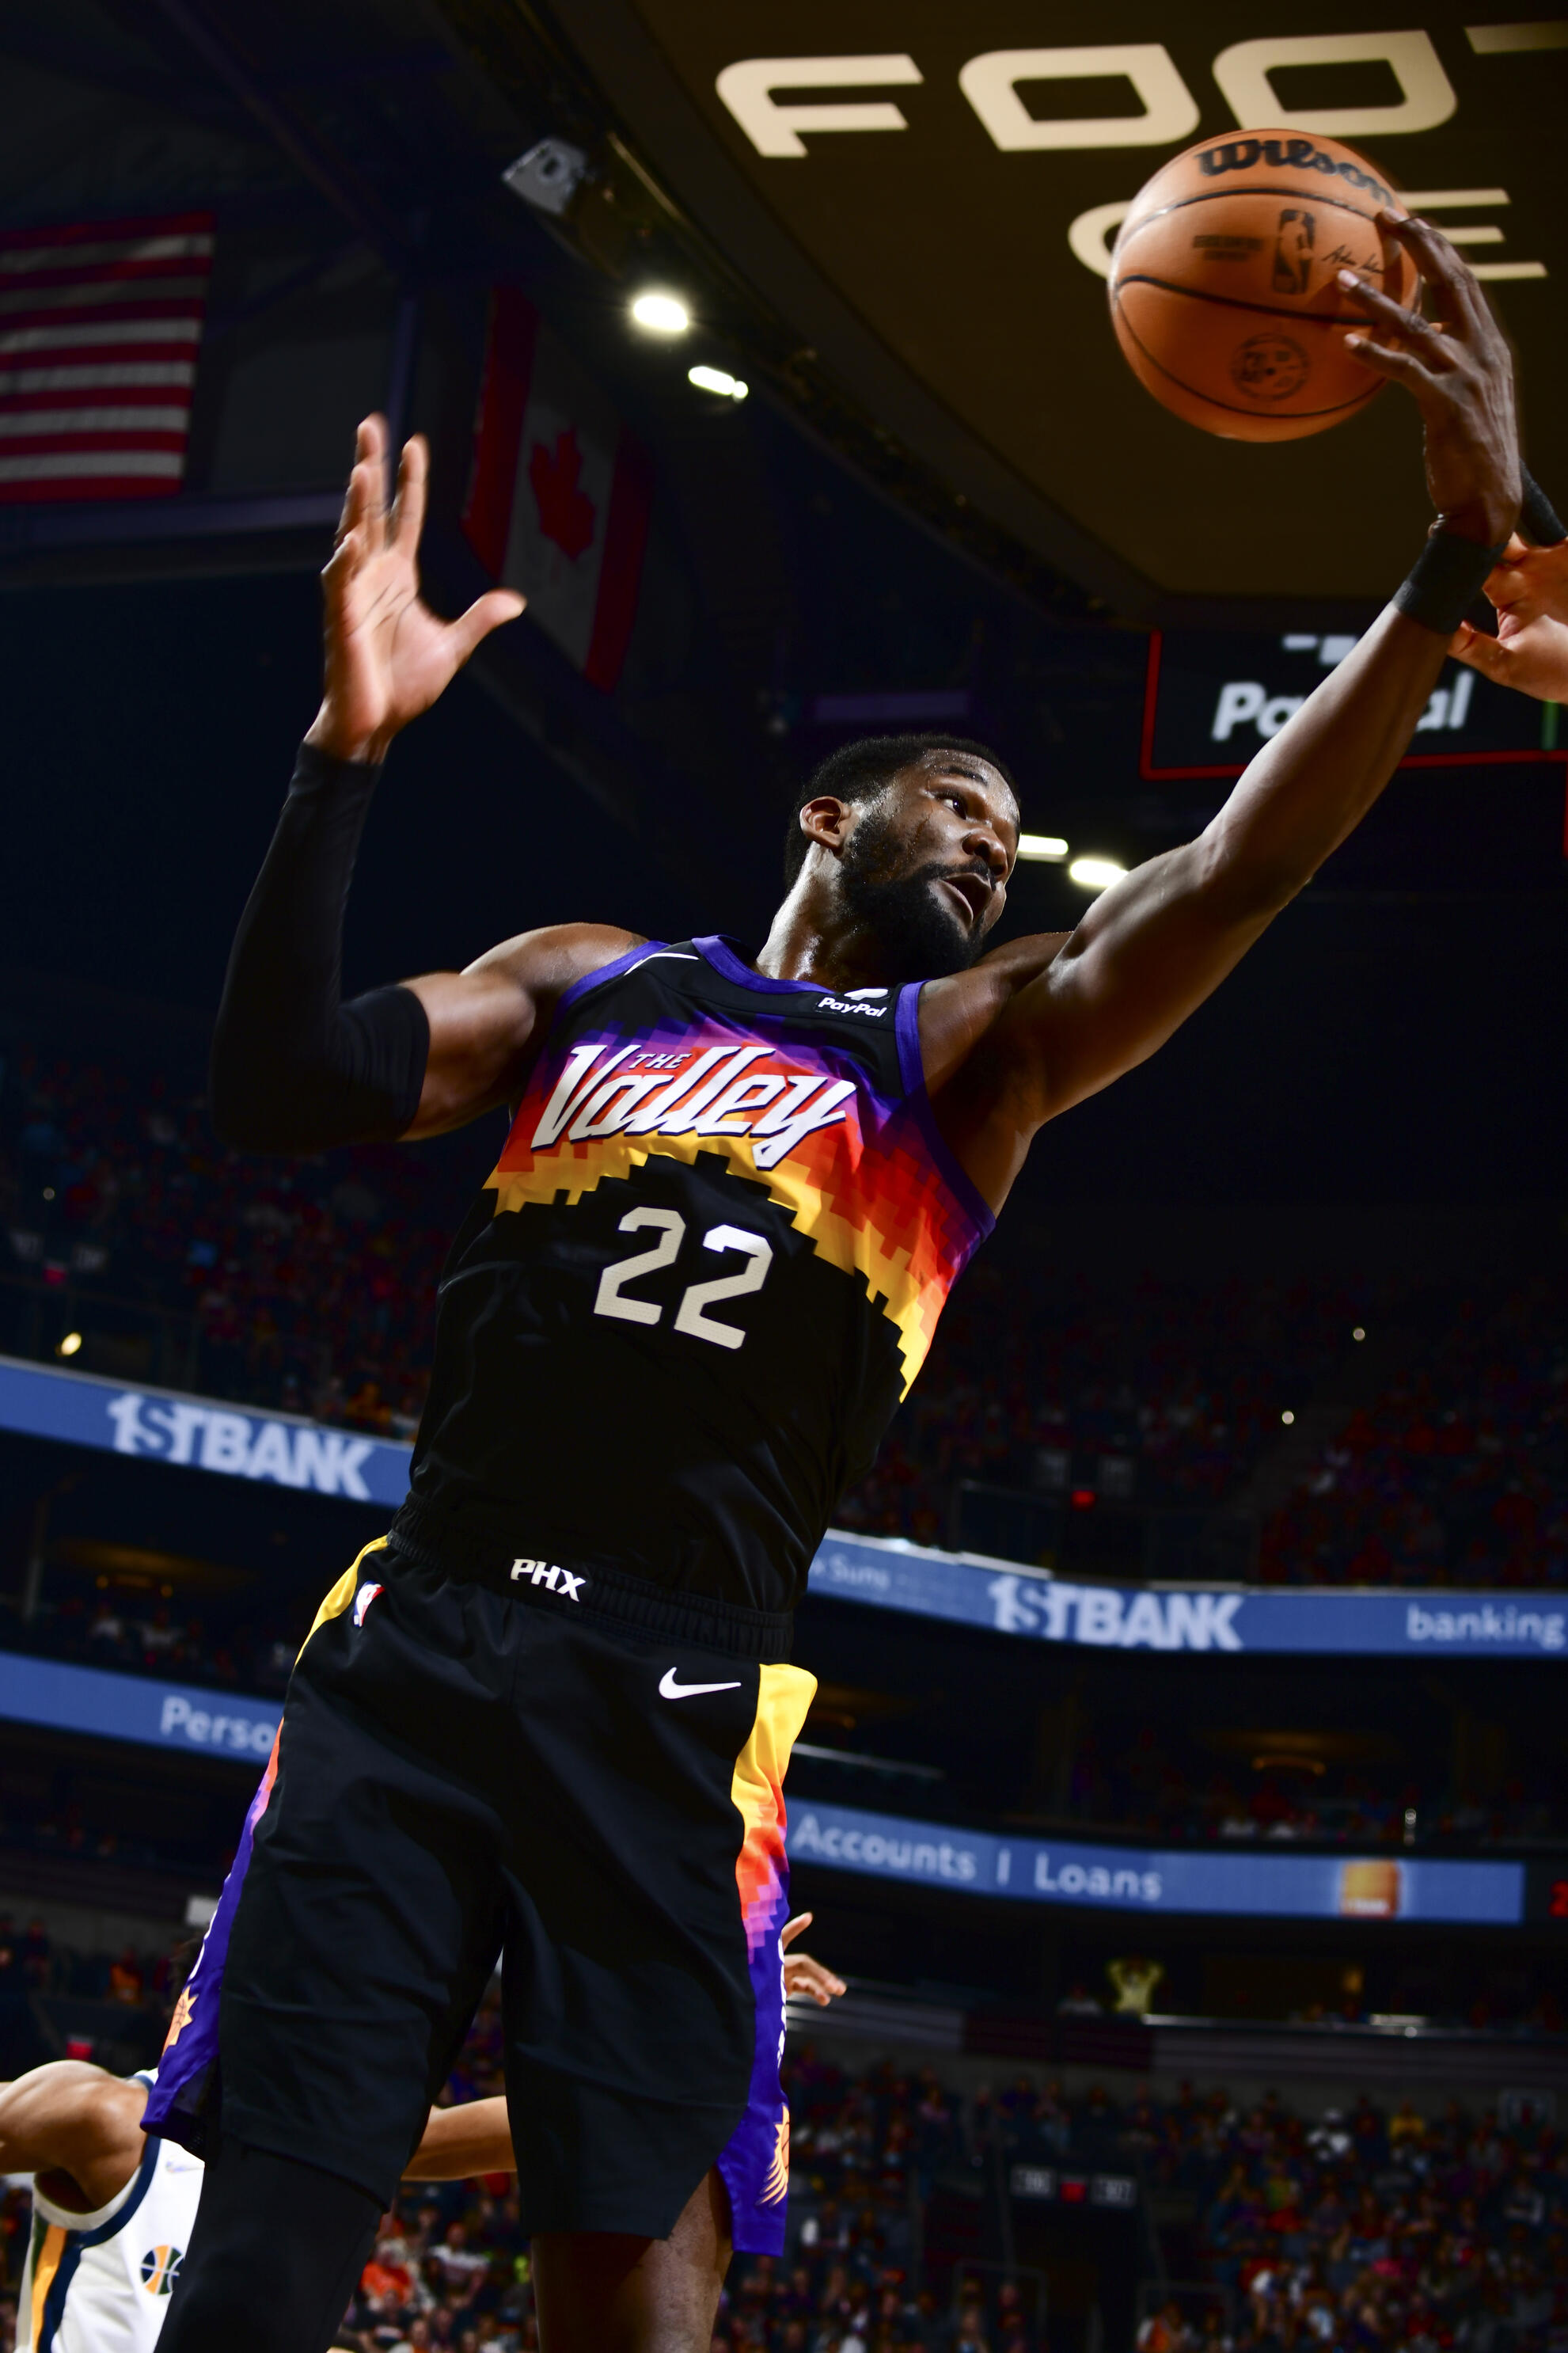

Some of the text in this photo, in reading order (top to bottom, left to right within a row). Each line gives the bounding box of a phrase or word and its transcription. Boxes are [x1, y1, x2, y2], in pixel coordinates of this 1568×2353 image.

[1193, 139, 1393, 207] Wilson
[1210, 669, 1477, 743] Paal
[818, 996, 887, 1018] PayPal
[628, 1051, 692, 1071] THE
[530, 1044, 858, 1171] Valley
[593, 1206, 774, 1351] 22
[510, 1558, 587, 1602] PHX
[1407, 1602, 1566, 1652] banking
[791, 1813, 978, 1881] Accounts
[1034, 1851, 1164, 1902] Loans
